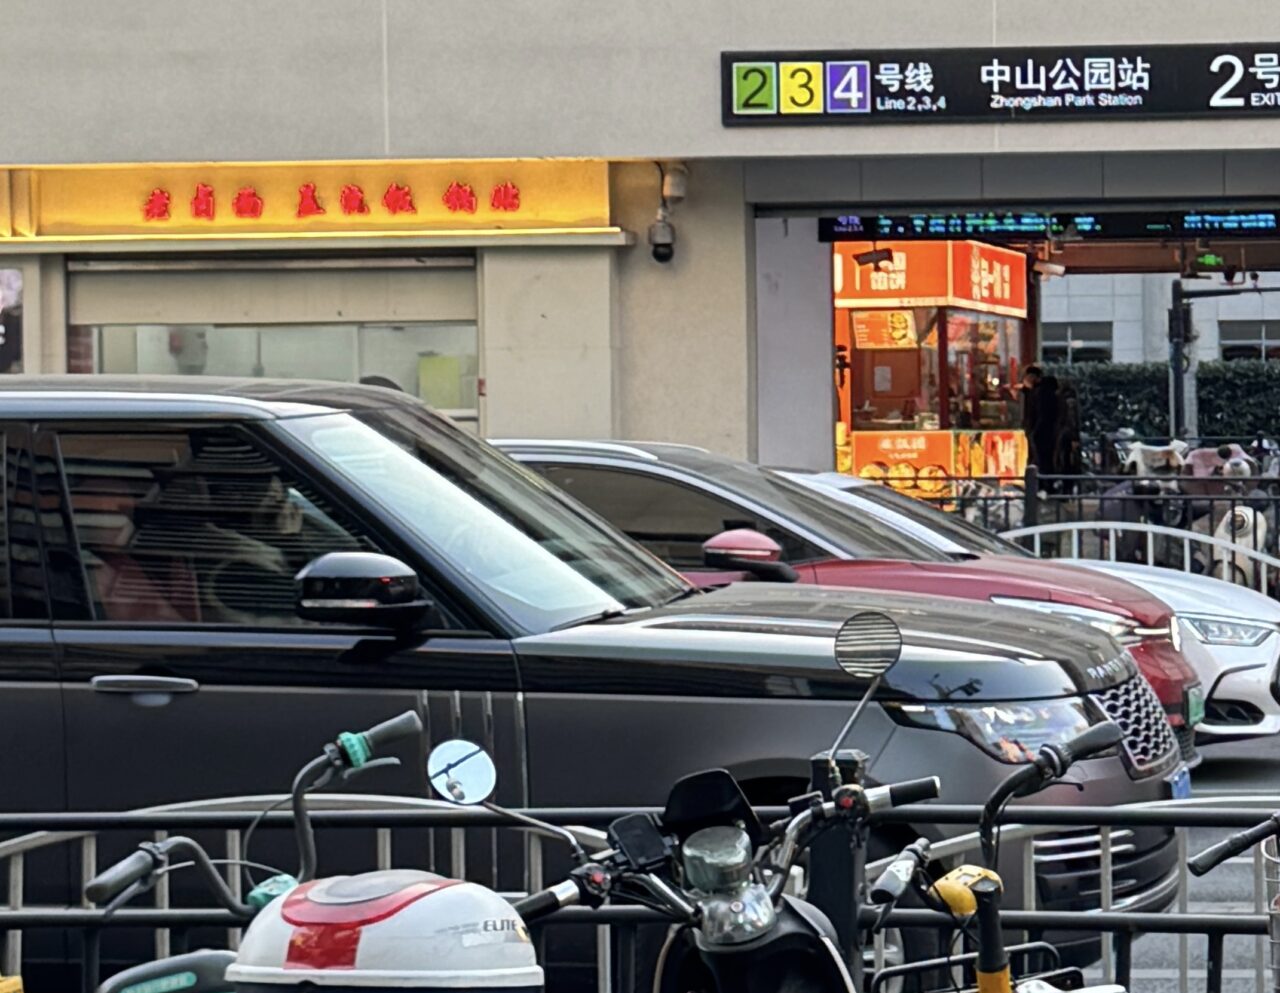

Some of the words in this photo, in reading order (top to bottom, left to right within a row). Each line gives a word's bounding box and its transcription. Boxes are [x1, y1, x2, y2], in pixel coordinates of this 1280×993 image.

[742, 67, 769, 108] 2
[789, 67, 815, 108] 3
[832, 65, 864, 108] 4
[875, 62, 935, 93] 号线
[980, 56, 1152, 93] 中山公园站
[990, 94, 1062, 110] Zhongshan
[1065, 93, 1095, 107] Park
[1098, 93, 1143, 107] Station
